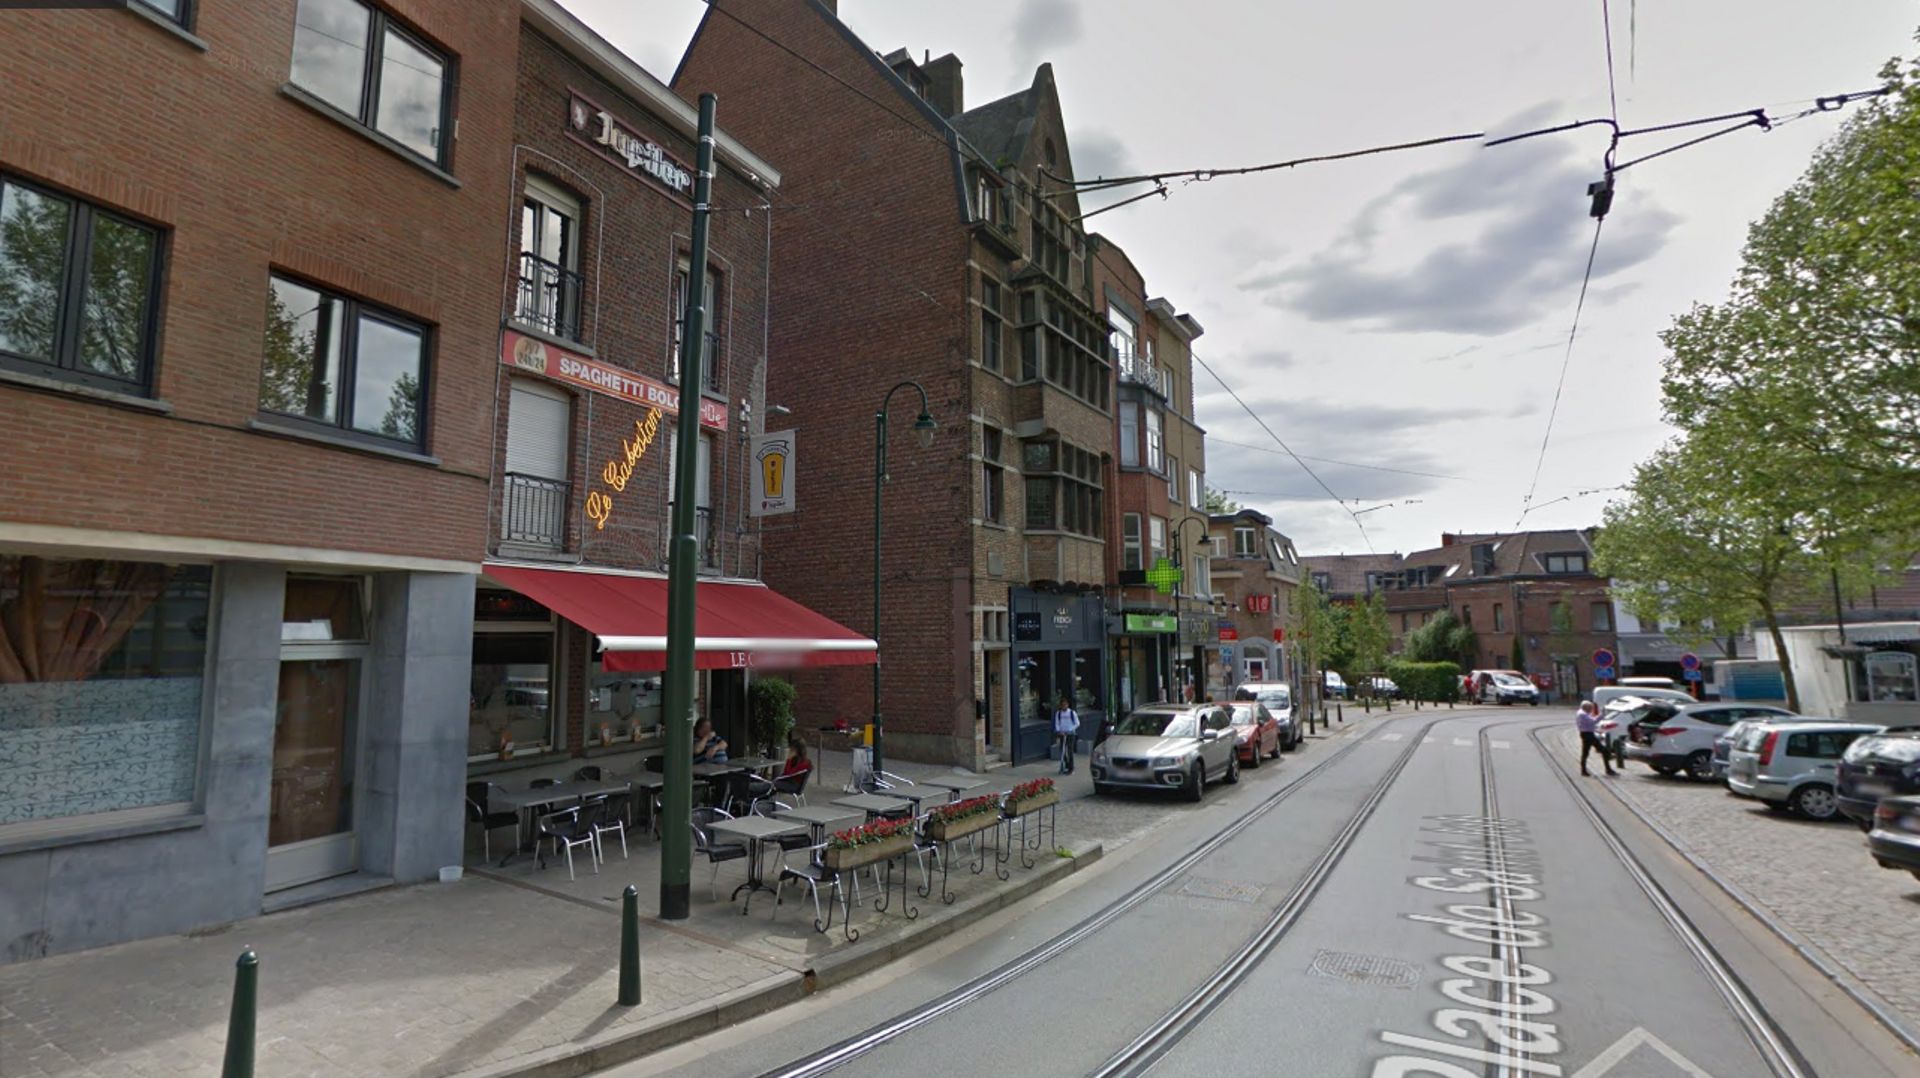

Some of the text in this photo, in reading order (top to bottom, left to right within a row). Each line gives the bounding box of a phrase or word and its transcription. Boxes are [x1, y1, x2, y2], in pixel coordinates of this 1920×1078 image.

[559, 357, 644, 398] SPAGHETTI
[586, 491, 612, 530] Le
[730, 652, 746, 667] LE
